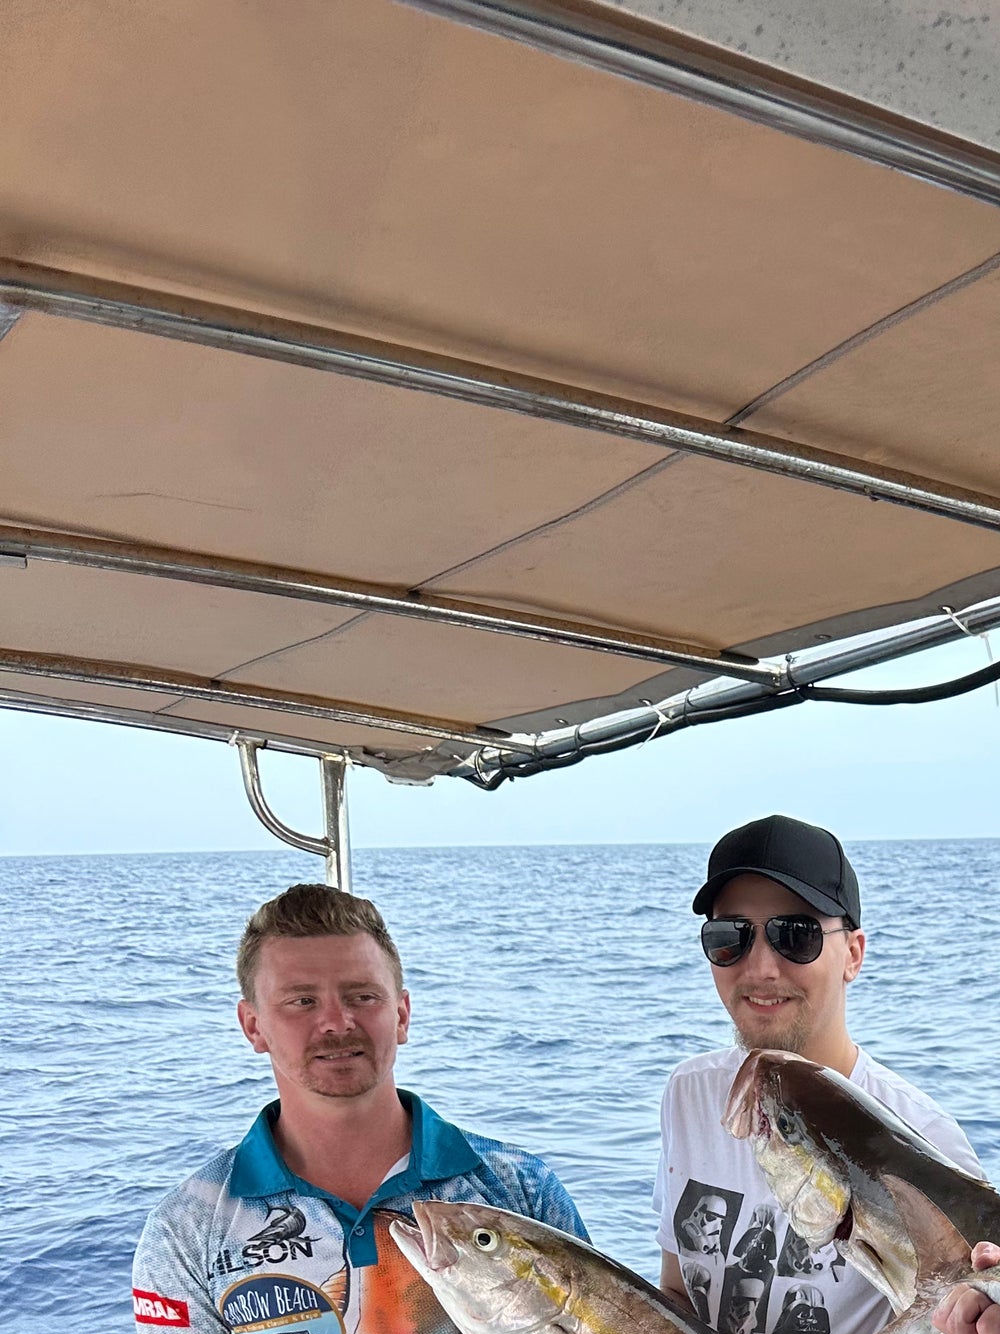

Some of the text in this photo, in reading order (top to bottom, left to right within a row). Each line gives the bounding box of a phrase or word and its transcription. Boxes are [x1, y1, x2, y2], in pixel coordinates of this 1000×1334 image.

[208, 1236, 313, 1280] ILSON
[223, 1285, 318, 1325] RAINBOW BEACH
